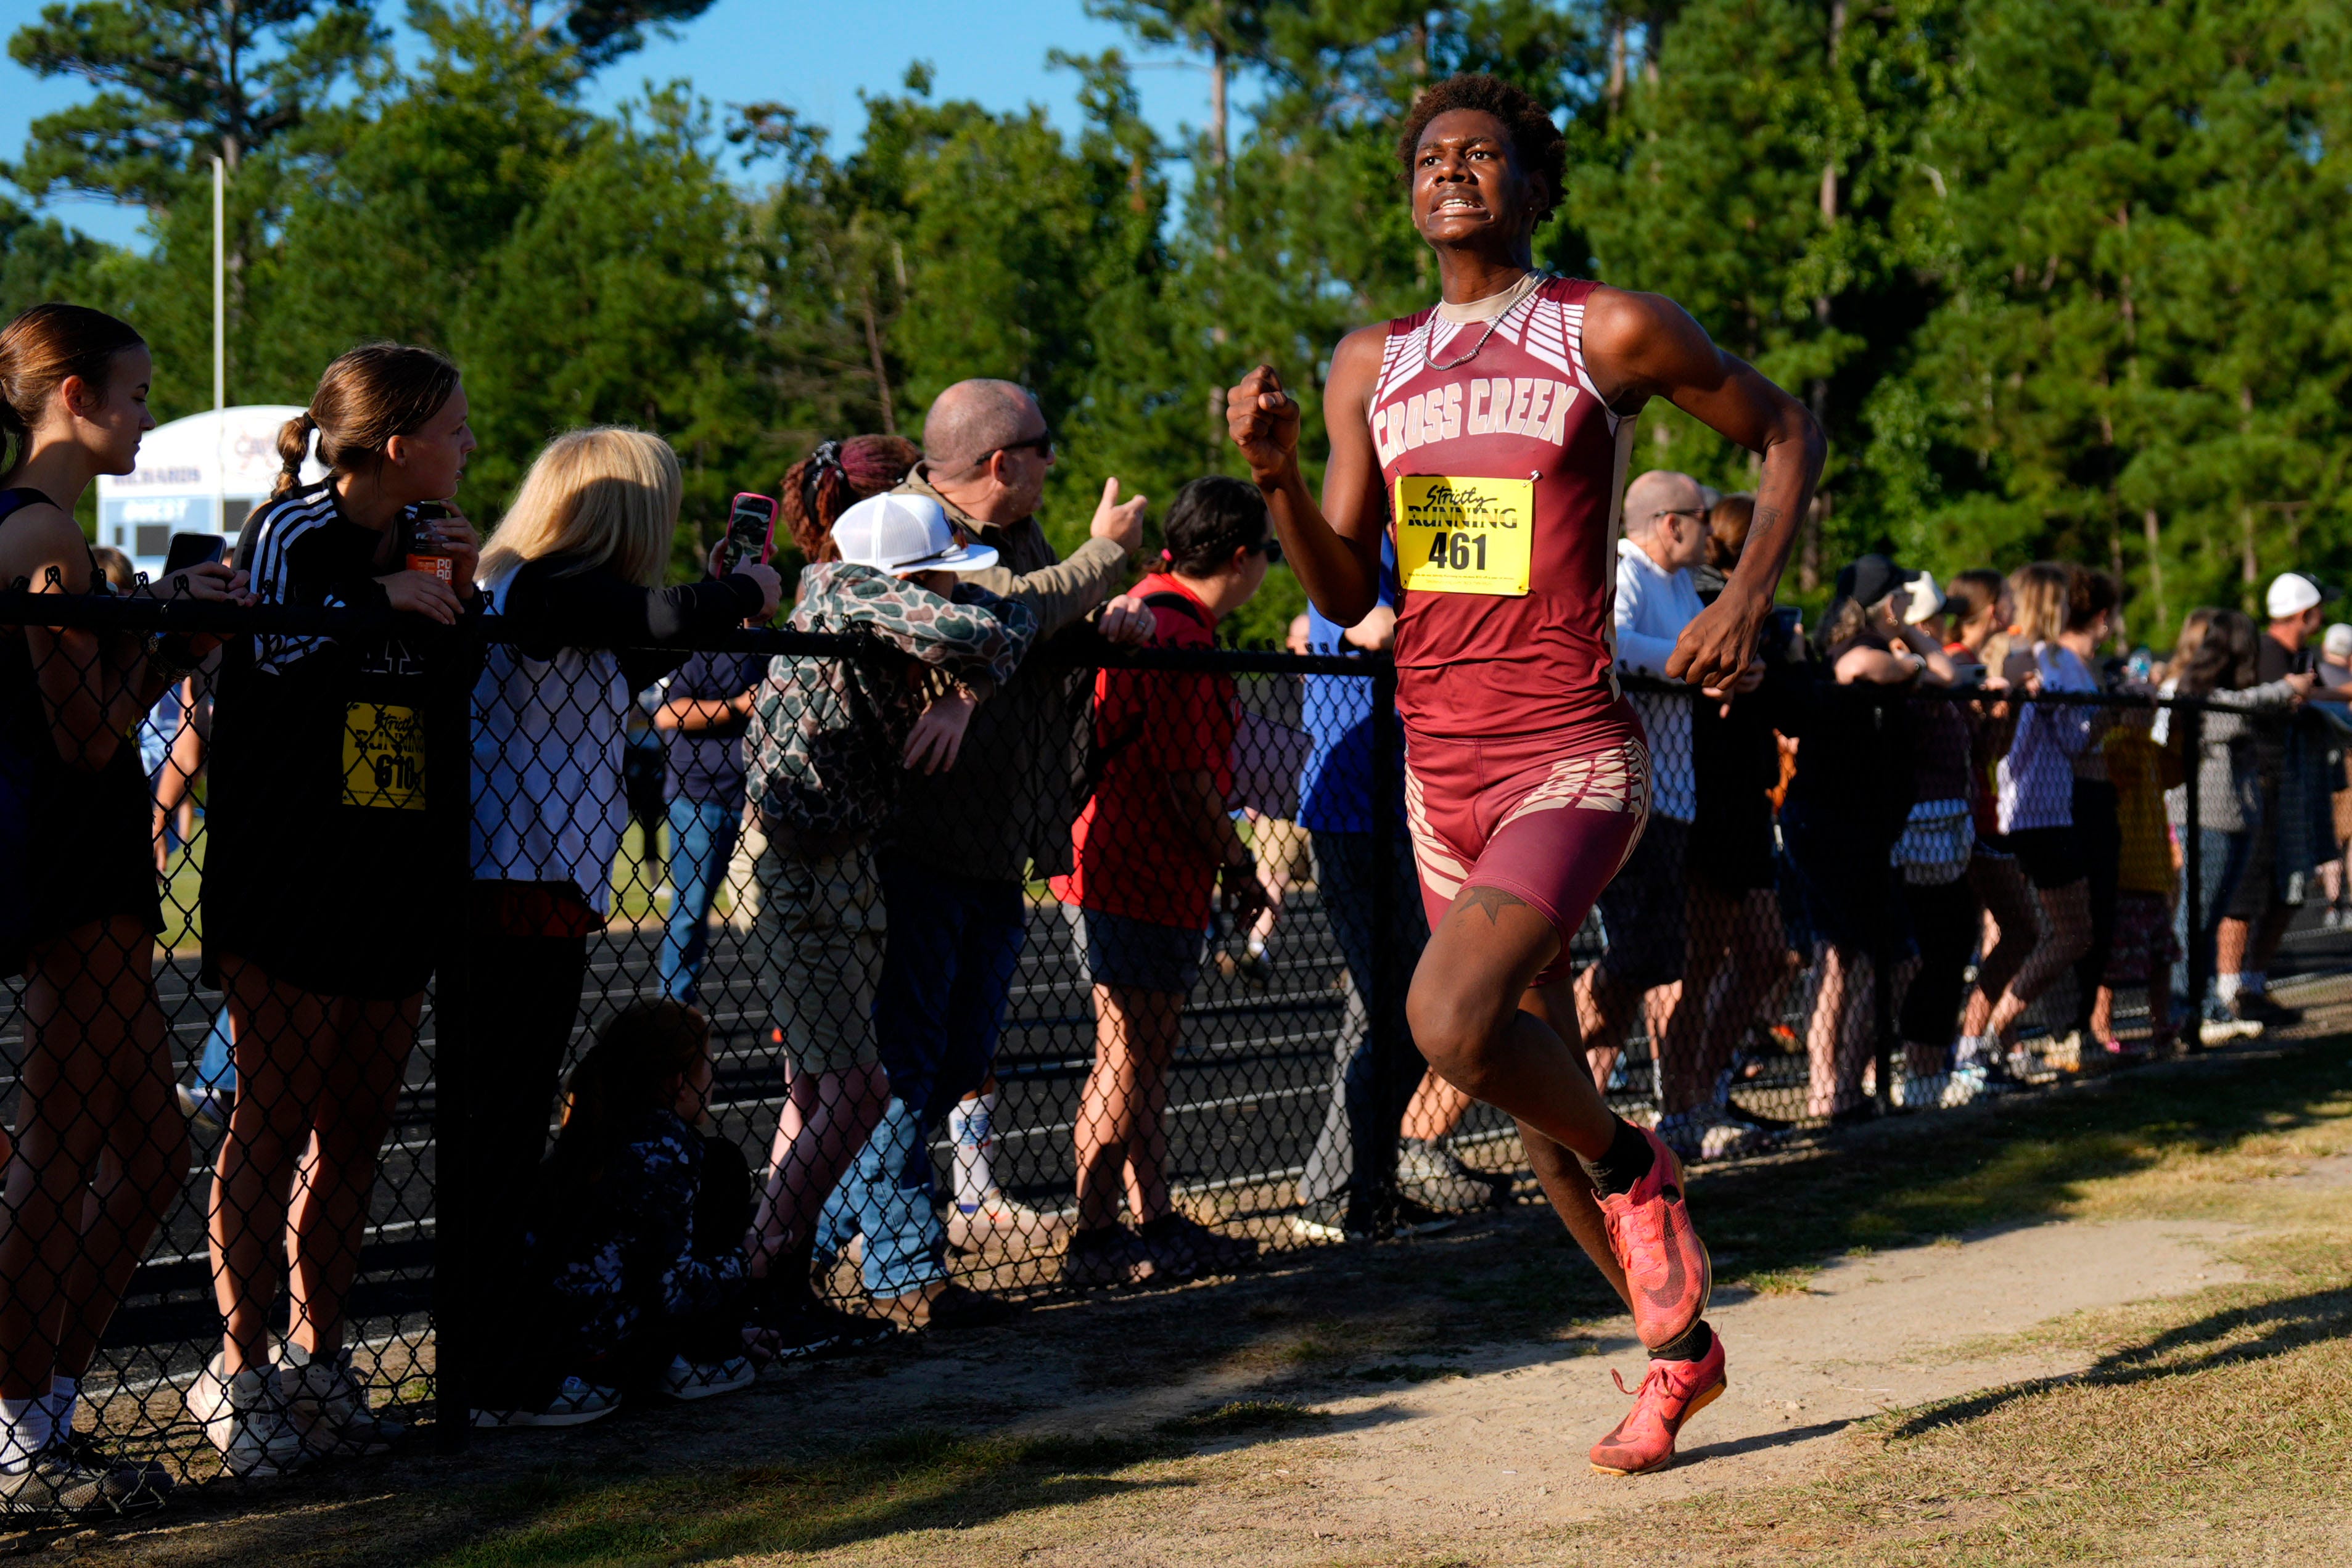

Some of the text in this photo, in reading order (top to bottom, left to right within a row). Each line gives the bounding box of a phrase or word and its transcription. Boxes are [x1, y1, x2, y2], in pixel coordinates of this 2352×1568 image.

[1373, 377, 1580, 469] CROSS CREEK
[1408, 505, 1518, 529] RUNNING
[1425, 484, 1498, 513] Strictly
[1428, 532, 1487, 570] 461
[374, 753, 415, 790] 610
